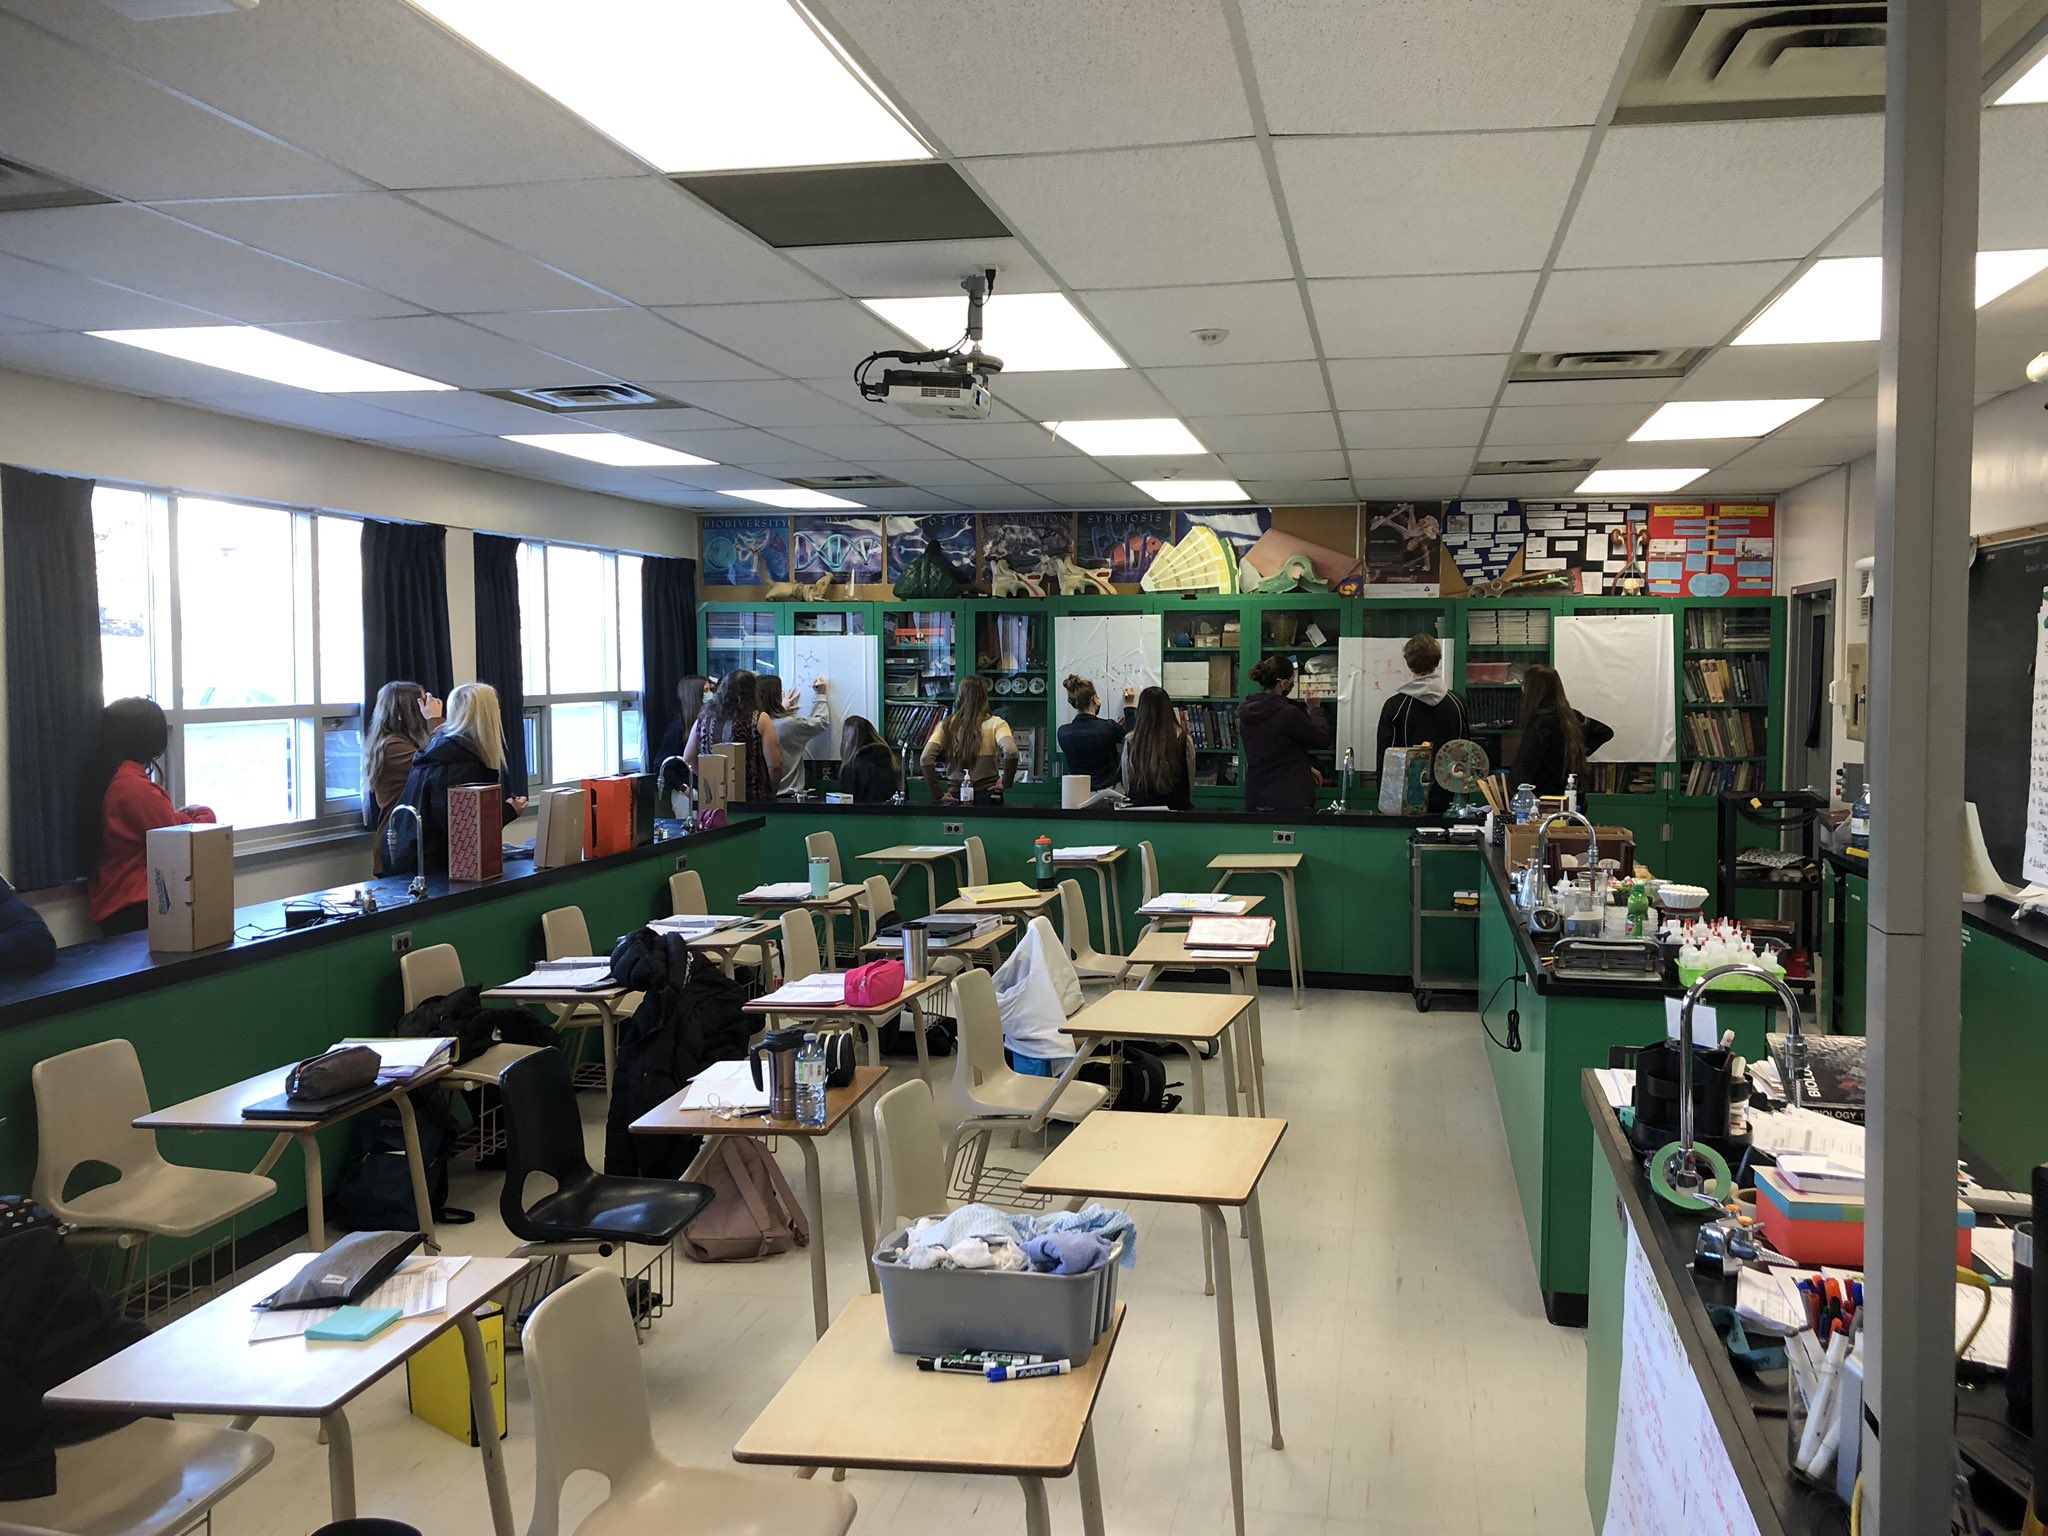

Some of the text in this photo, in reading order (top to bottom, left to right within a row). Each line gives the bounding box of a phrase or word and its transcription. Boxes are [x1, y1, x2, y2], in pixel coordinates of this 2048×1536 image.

[825, 516, 850, 525] DNA
[1087, 513, 1163, 523] SYMBIOSIS
[703, 518, 788, 529] BIODIVERSITY
[1803, 1063, 1822, 1098] BIOLO
